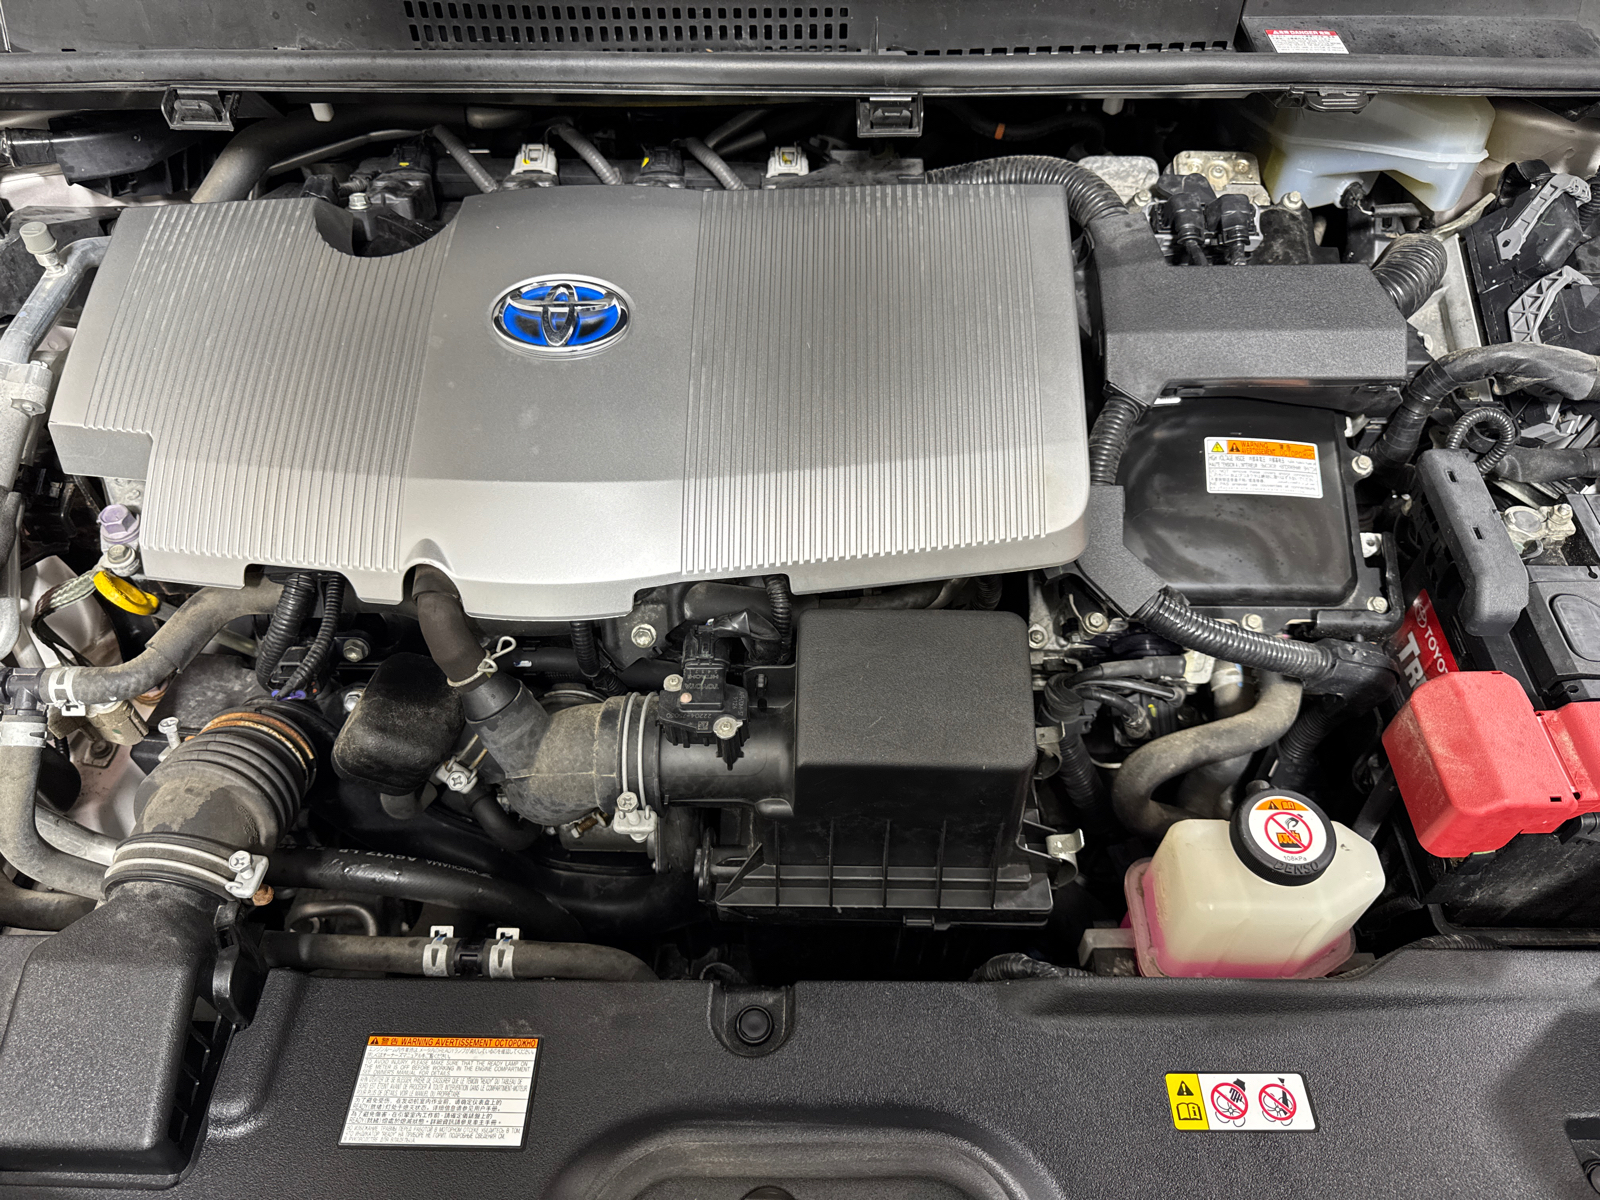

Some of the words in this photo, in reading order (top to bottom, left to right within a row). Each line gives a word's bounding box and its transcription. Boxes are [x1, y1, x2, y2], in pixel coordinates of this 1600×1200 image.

[1241, 441, 1268, 449] WARNING
[1424, 625, 1449, 674] TOYO
[1398, 631, 1427, 691] TR
[426, 859, 479, 875] YOKOHAMA
[1273, 861, 1319, 874] DENSO
[400, 1037, 434, 1046] WARNING
[434, 1038, 493, 1046] AVERTISSEMENT
[493, 1038, 537, 1047] ОСТОРОЖНО
